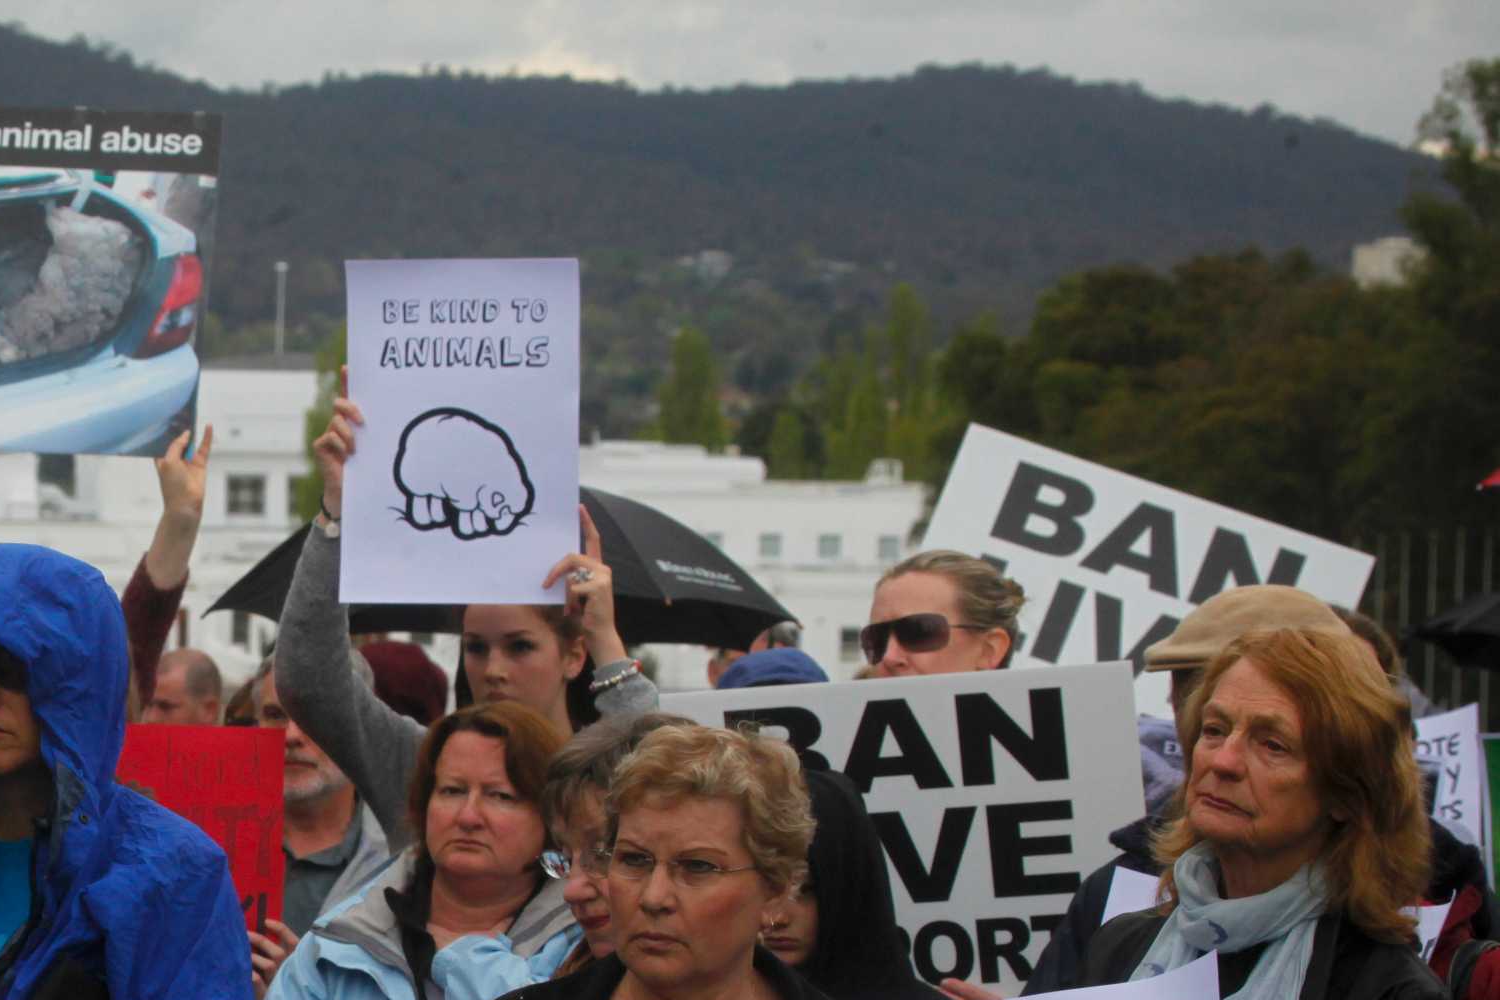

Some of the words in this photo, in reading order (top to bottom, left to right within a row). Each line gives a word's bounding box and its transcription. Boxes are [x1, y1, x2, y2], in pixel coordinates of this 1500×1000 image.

[100, 125, 203, 156] abuse
[382, 299, 421, 325] BE
[429, 299, 501, 325] KIND
[510, 299, 549, 324] TO
[379, 336, 550, 370] ANIMALS
[989, 461, 1307, 606] BAN
